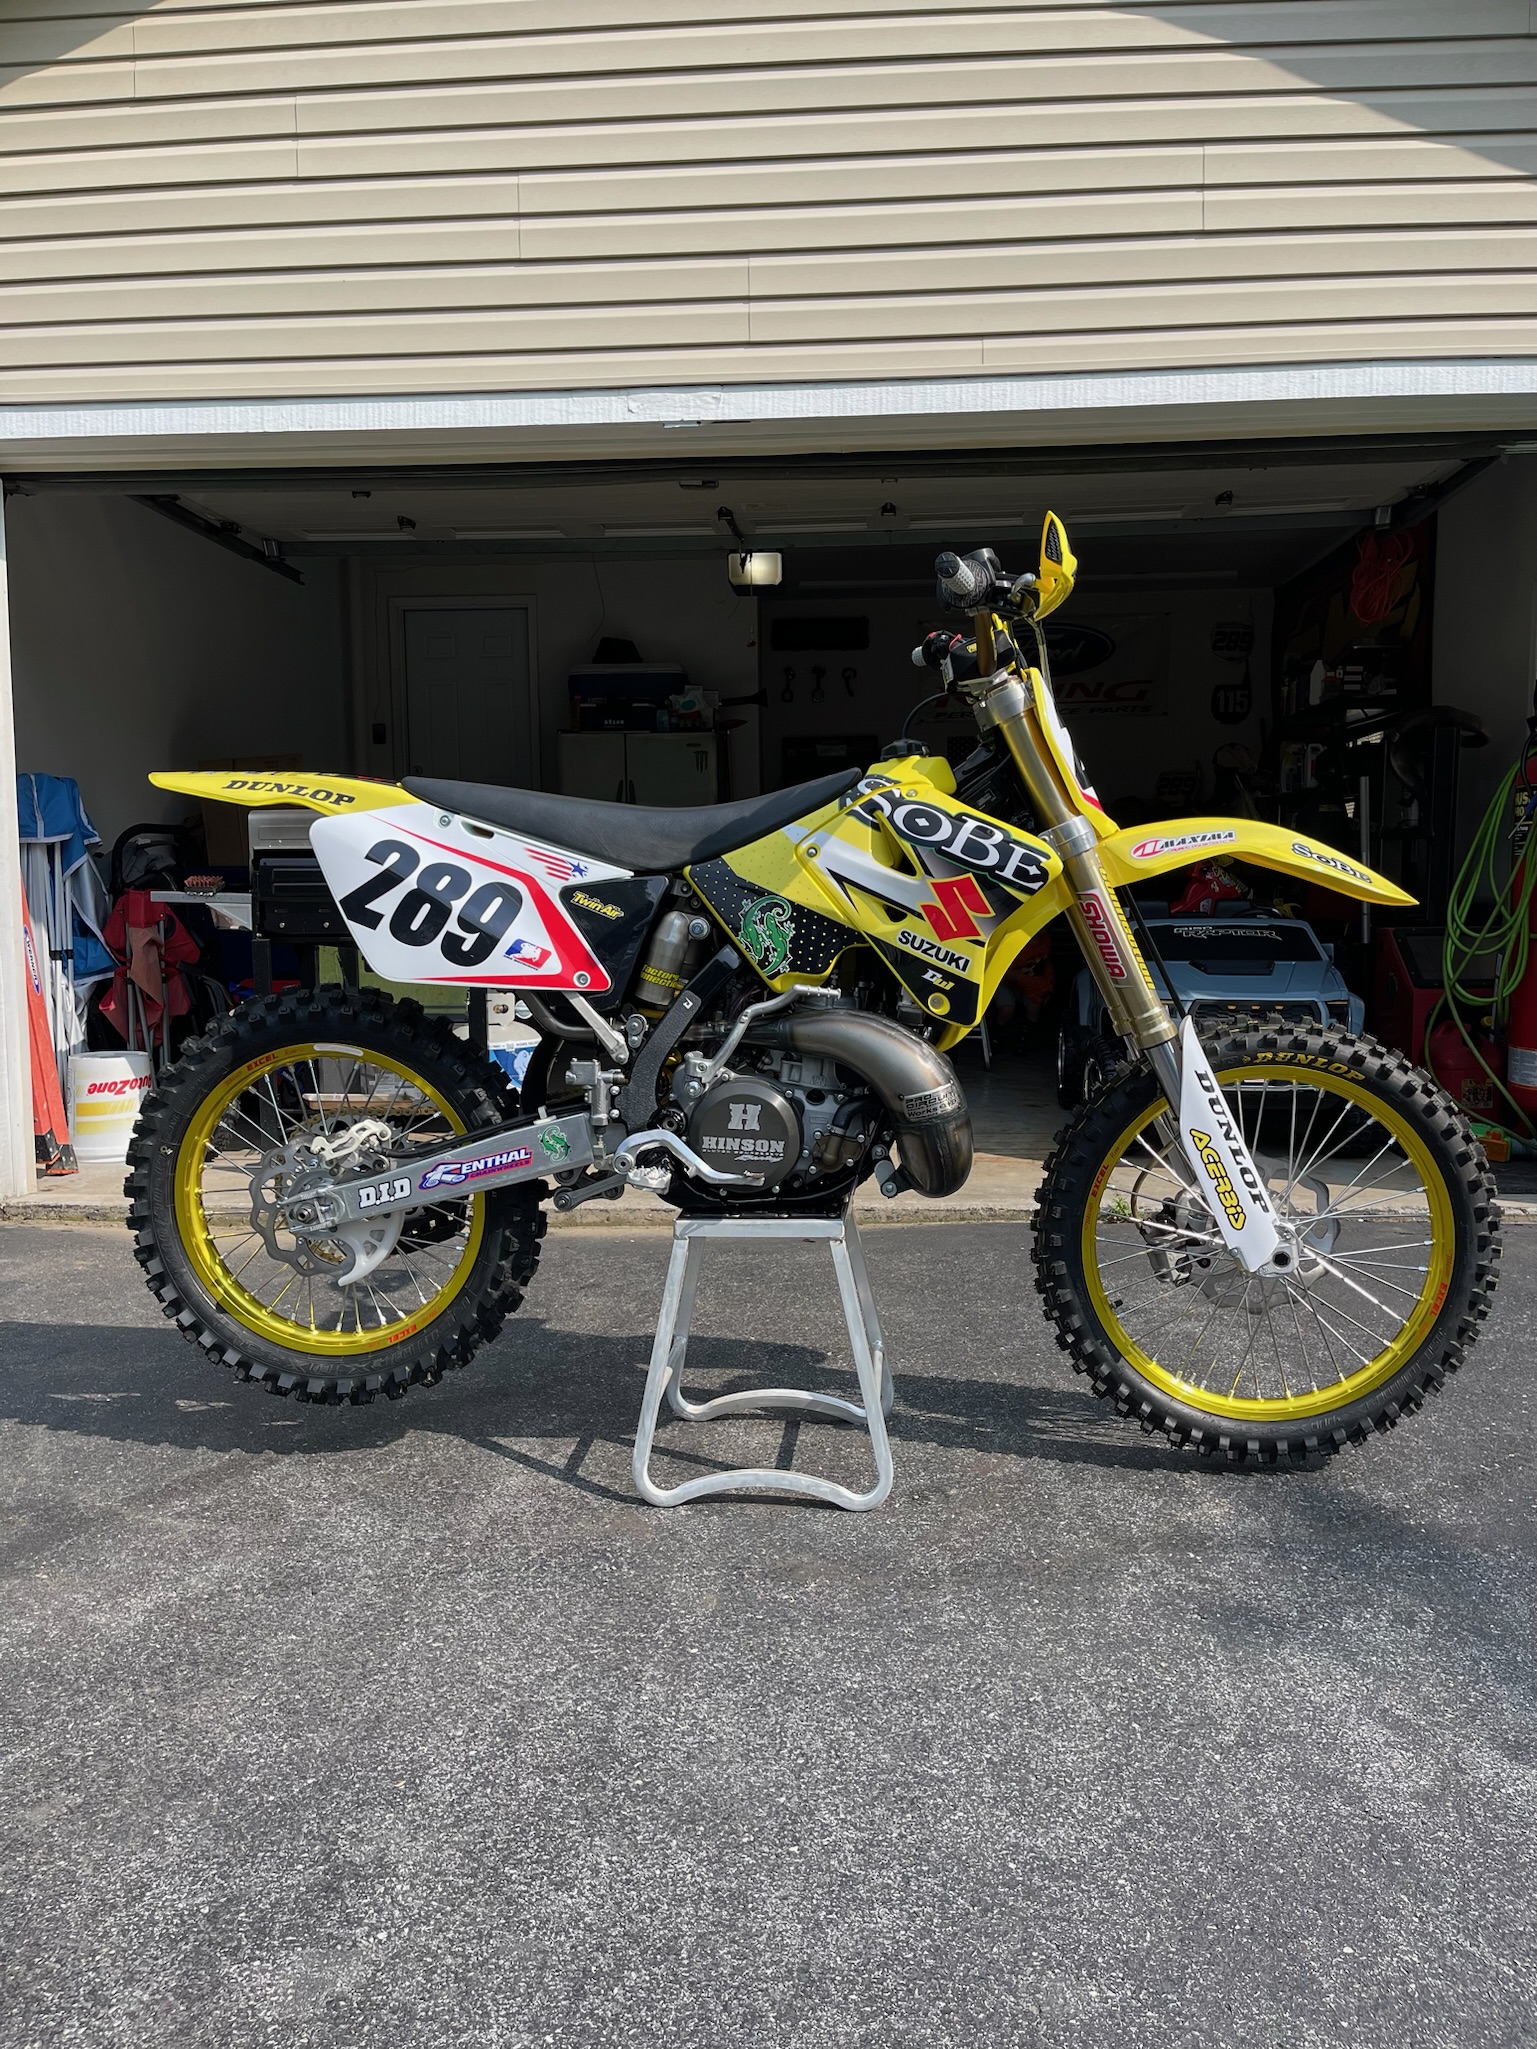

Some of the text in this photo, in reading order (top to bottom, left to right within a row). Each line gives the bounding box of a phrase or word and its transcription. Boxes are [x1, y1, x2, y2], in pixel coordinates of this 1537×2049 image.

[1216, 689, 1249, 714] 115
[222, 779, 356, 806] DUNLOP
[338, 838, 523, 968] 289
[572, 891, 624, 919] Twin Air
[897, 929, 972, 974] SUZUKI
[1079, 899, 1128, 980] SHOWA
[246, 1053, 279, 1072] EXCEL
[1252, 1050, 1367, 1082] DUNLOP
[727, 1102, 762, 1131] H
[701, 1135, 786, 1154] HINSON
[1194, 1069, 1271, 1214] DUNLOP
[423, 1148, 532, 1189] RENTHAL
[1090, 1163, 1110, 1199] EXCEL
[1189, 1127, 1247, 1231] ACERBIS
[358, 1178, 411, 1209] D.I.D
[1429, 1281, 1449, 1318] EXCEL
[387, 1324, 418, 1345] EXCEL
